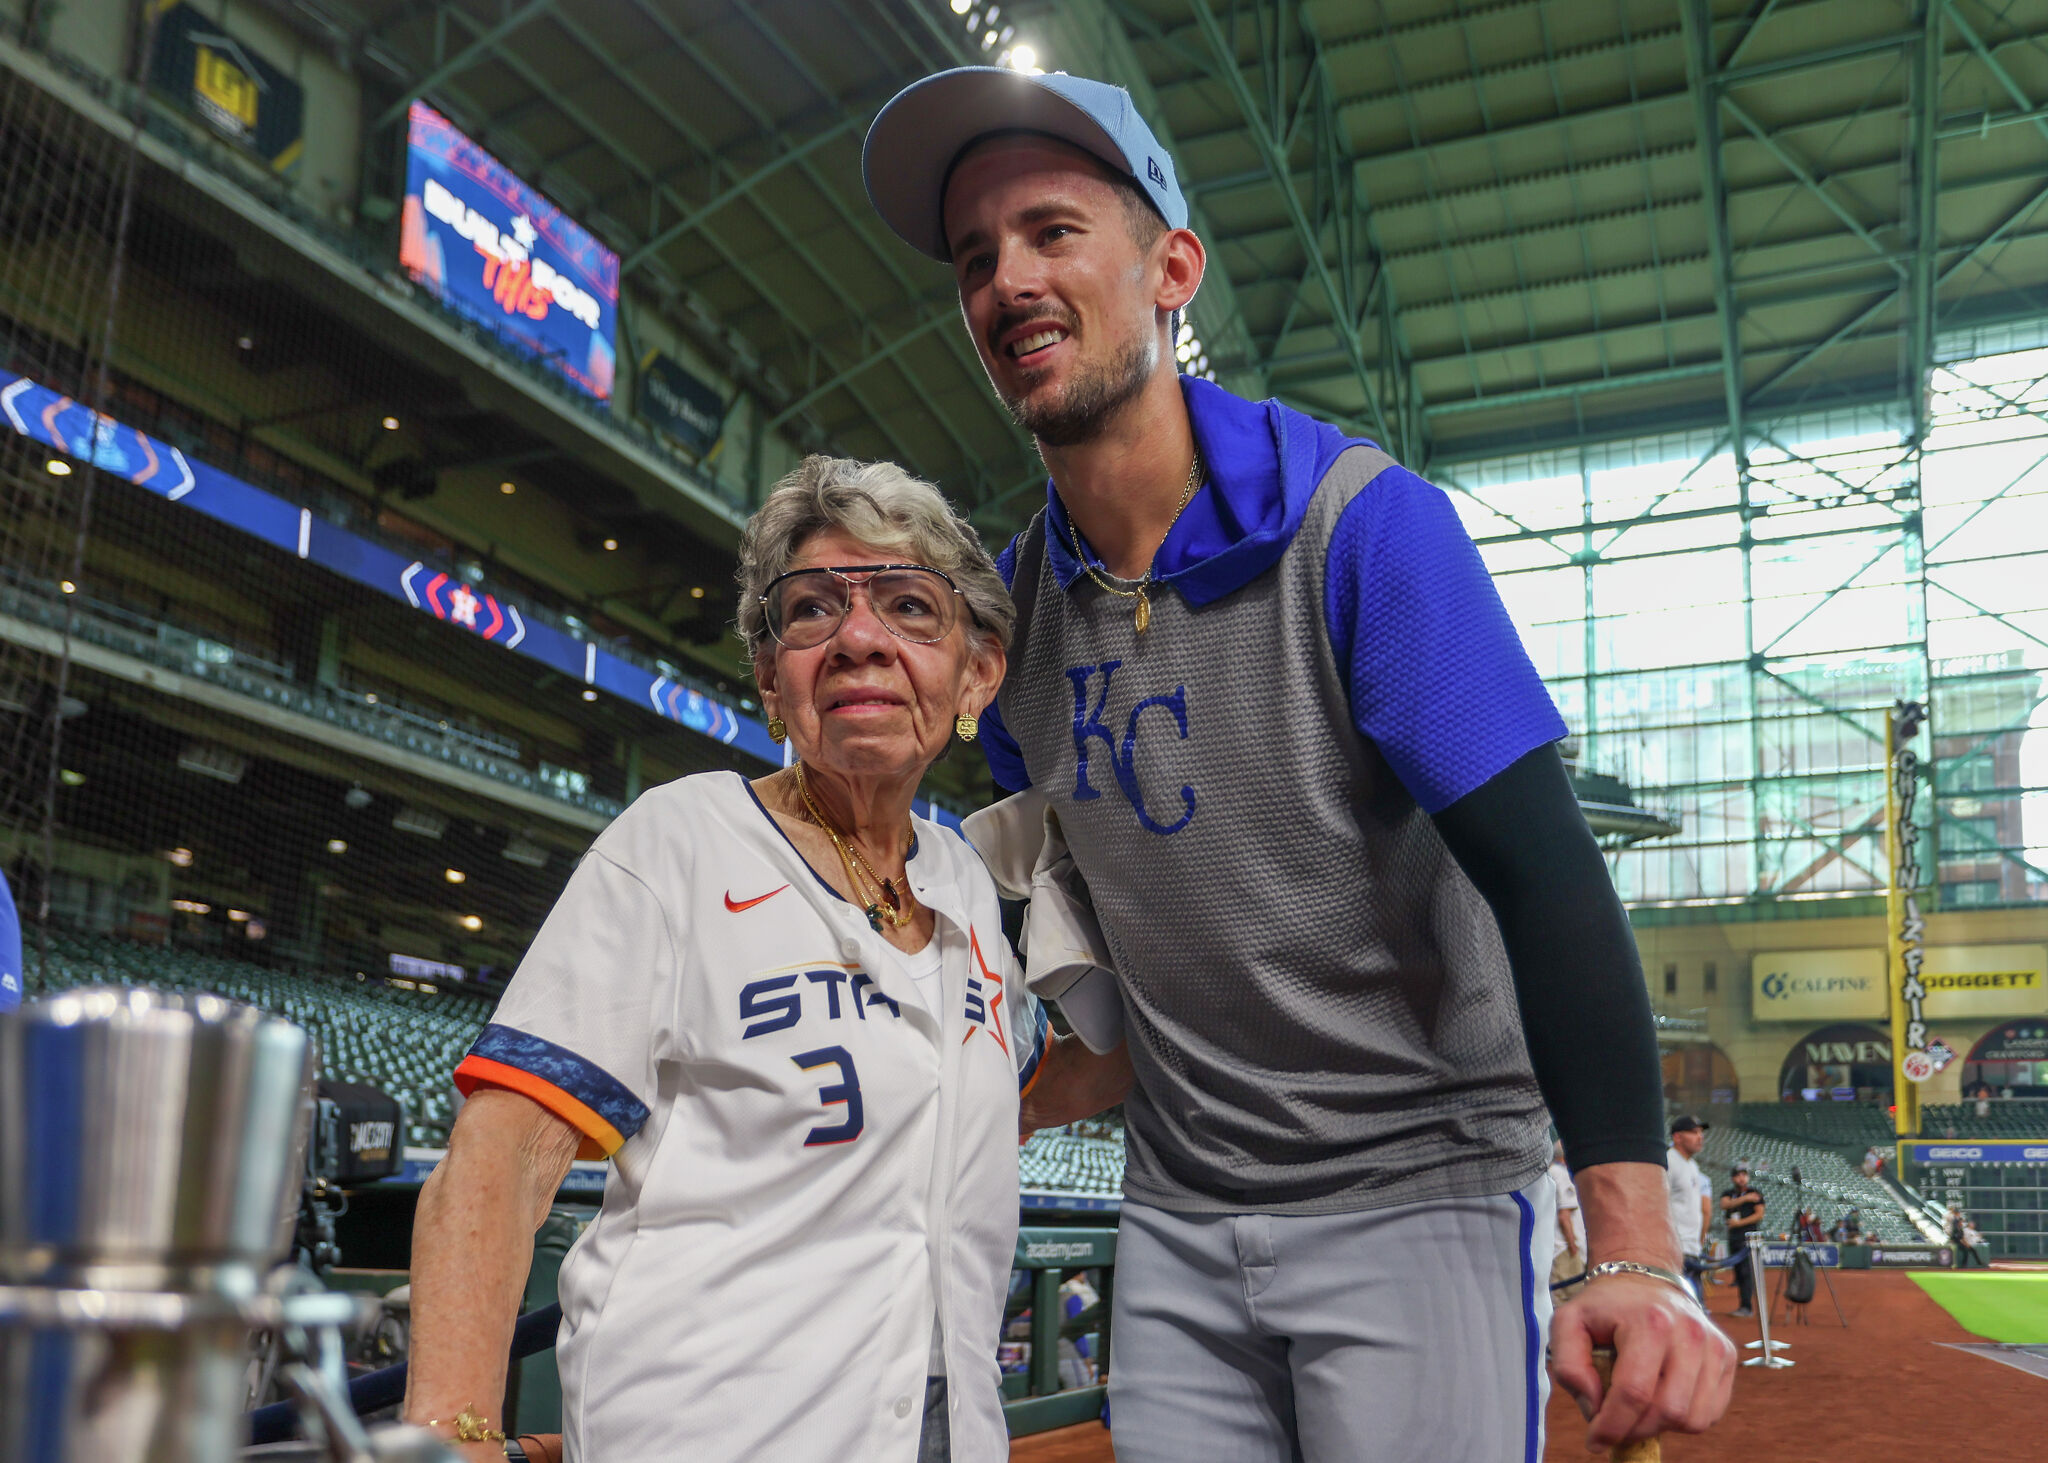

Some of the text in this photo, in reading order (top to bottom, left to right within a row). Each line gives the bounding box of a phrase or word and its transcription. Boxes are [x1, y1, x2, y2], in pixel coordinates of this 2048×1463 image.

[424, 178, 600, 330] BUILT FOR
[474, 243, 554, 321] THIS
[1065, 660, 1196, 836] KC
[739, 967, 986, 1040] STAS
[1791, 977, 1874, 993] CALPINE
[1903, 949, 1927, 1049] FAIR
[1806, 1041, 1892, 1064] MAVEN
[789, 1045, 864, 1147] 3
[1929, 1147, 1982, 1159] GEICO
[1026, 1239, 1094, 1260] academy.com
